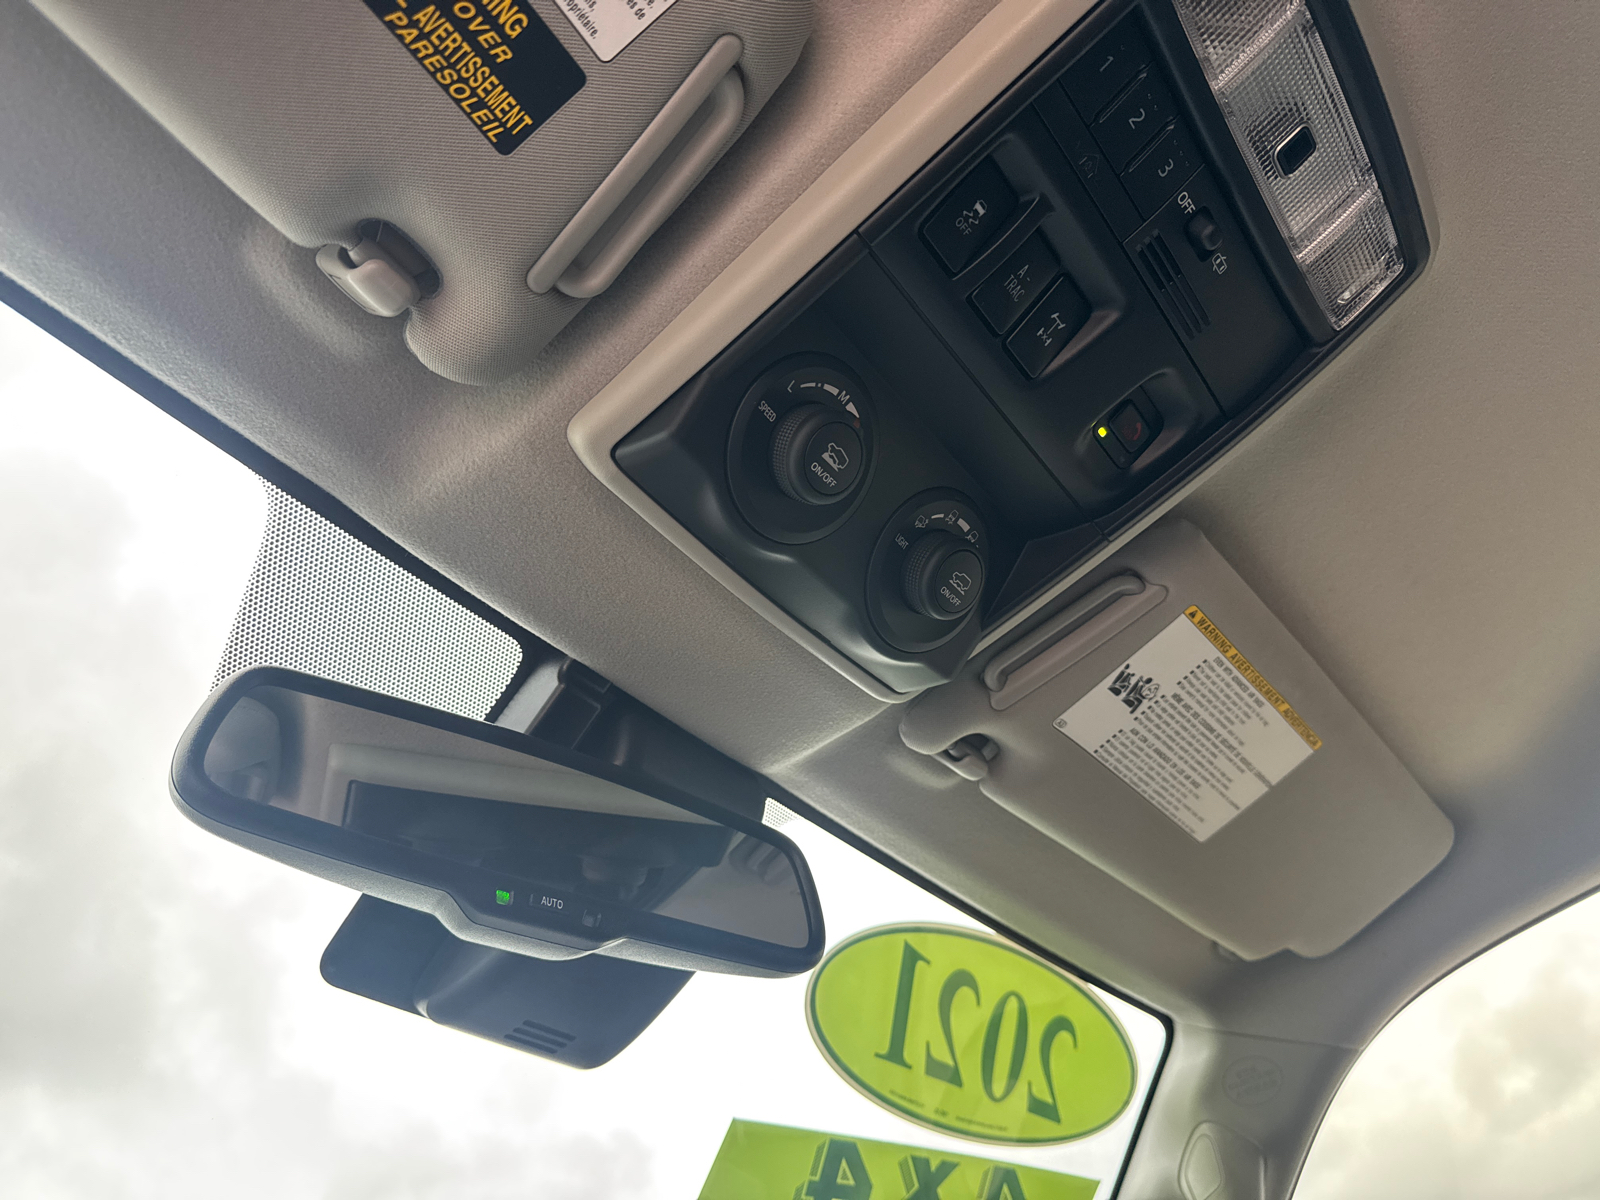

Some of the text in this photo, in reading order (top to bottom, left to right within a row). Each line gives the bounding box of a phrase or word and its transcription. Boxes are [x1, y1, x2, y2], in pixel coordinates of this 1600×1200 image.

[482, 0, 529, 39] ING
[563, 0, 598, 39] opriétaire.
[634, 8, 646, 20] de
[453, 1, 513, 64] OVER
[412, 5, 533, 136] AVERTISSEMENT
[1099, 55, 1114, 72] 1
[384, 11, 505, 143] PARESOLEIL
[1128, 108, 1146, 129] 2
[1157, 158, 1174, 178] 3
[1177, 191, 1196, 215] OFF
[955, 217, 972, 236] OFF
[1003, 274, 1026, 302] TRAC
[786, 379, 795, 393] L
[837, 390, 851, 405] M
[757, 400, 777, 423] SPEED
[810, 462, 838, 488] ON/OFF
[894, 533, 909, 549] LIGHT
[940, 586, 962, 607] ON/OFF
[1196, 616, 1232, 654] WARNING
[1229, 652, 1286, 708] AVERTISSEMENT
[540, 896, 564, 909] AUTO
